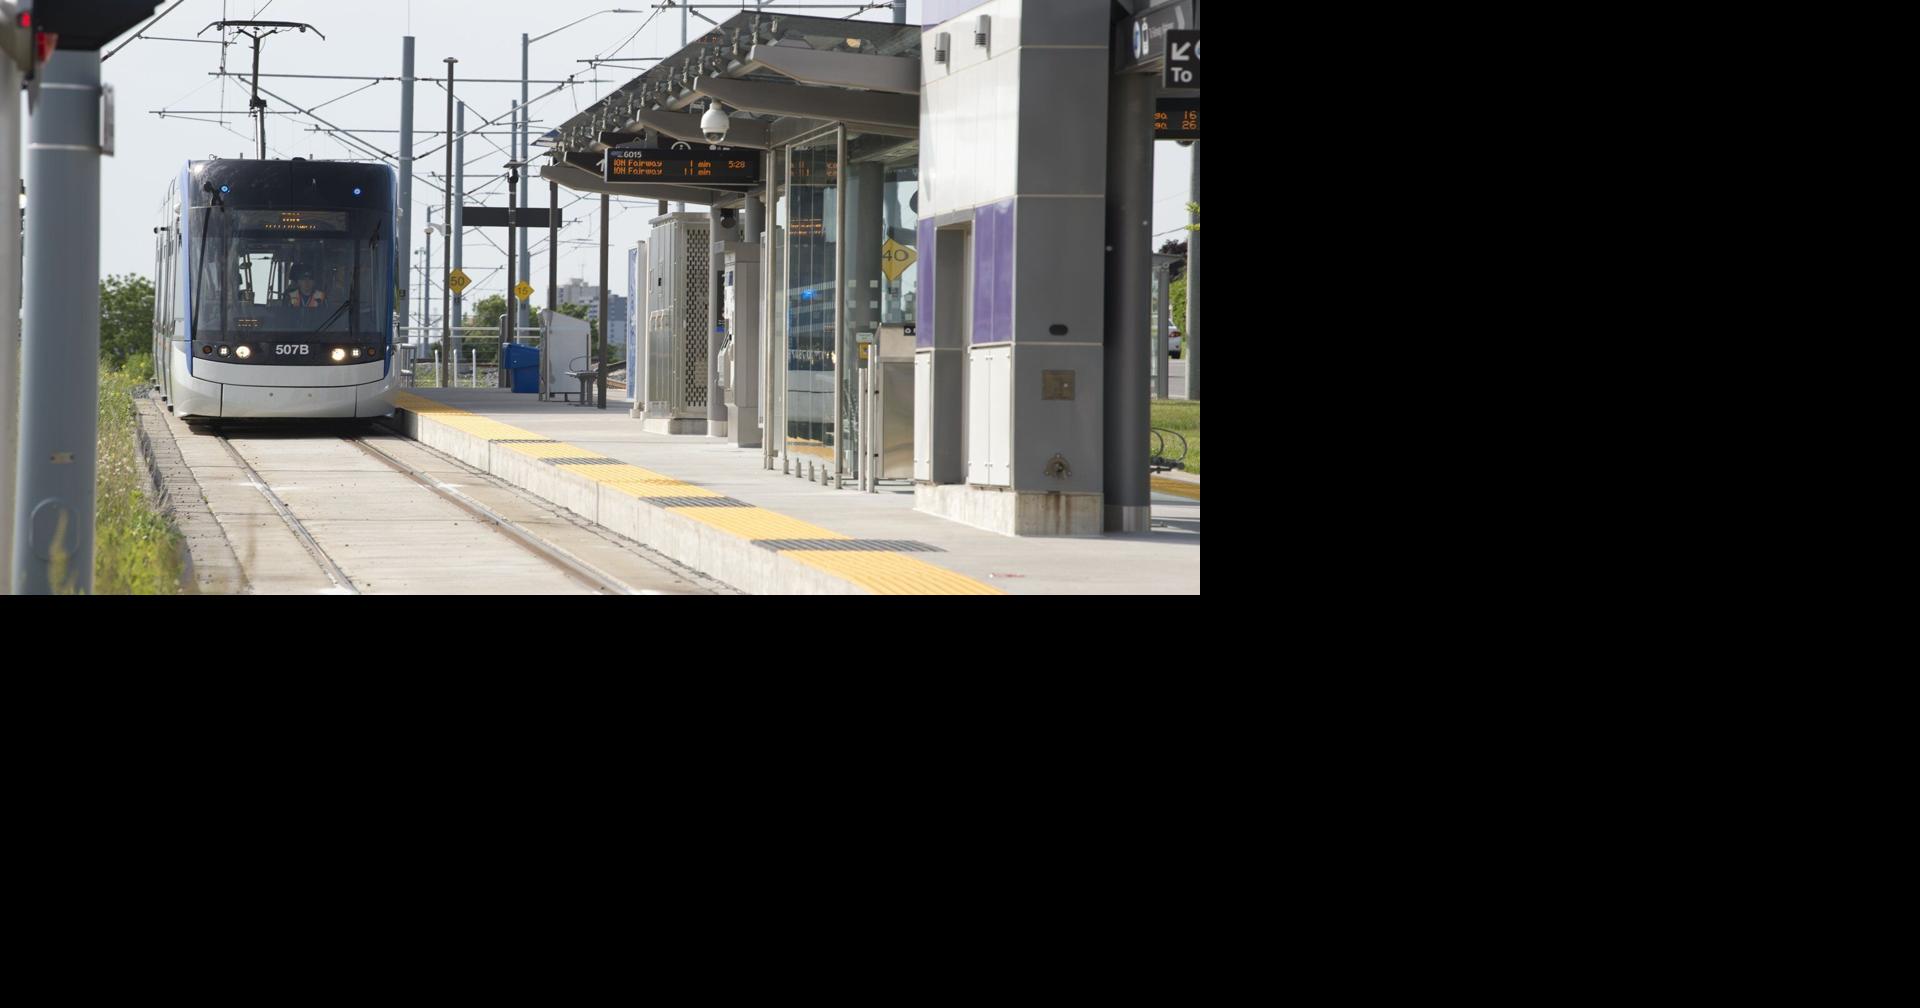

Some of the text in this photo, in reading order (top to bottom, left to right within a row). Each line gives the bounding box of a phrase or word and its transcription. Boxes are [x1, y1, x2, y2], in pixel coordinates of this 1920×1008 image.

[1171, 67, 1192, 82] To
[1182, 120, 1197, 130] 26
[628, 159, 663, 167] Fairway
[698, 160, 711, 168] min
[628, 167, 663, 175] Fairway
[698, 168, 711, 176] min
[883, 249, 909, 262] 40
[450, 276, 465, 287] 50
[518, 286, 528, 295] 15
[275, 344, 310, 356] 507B
